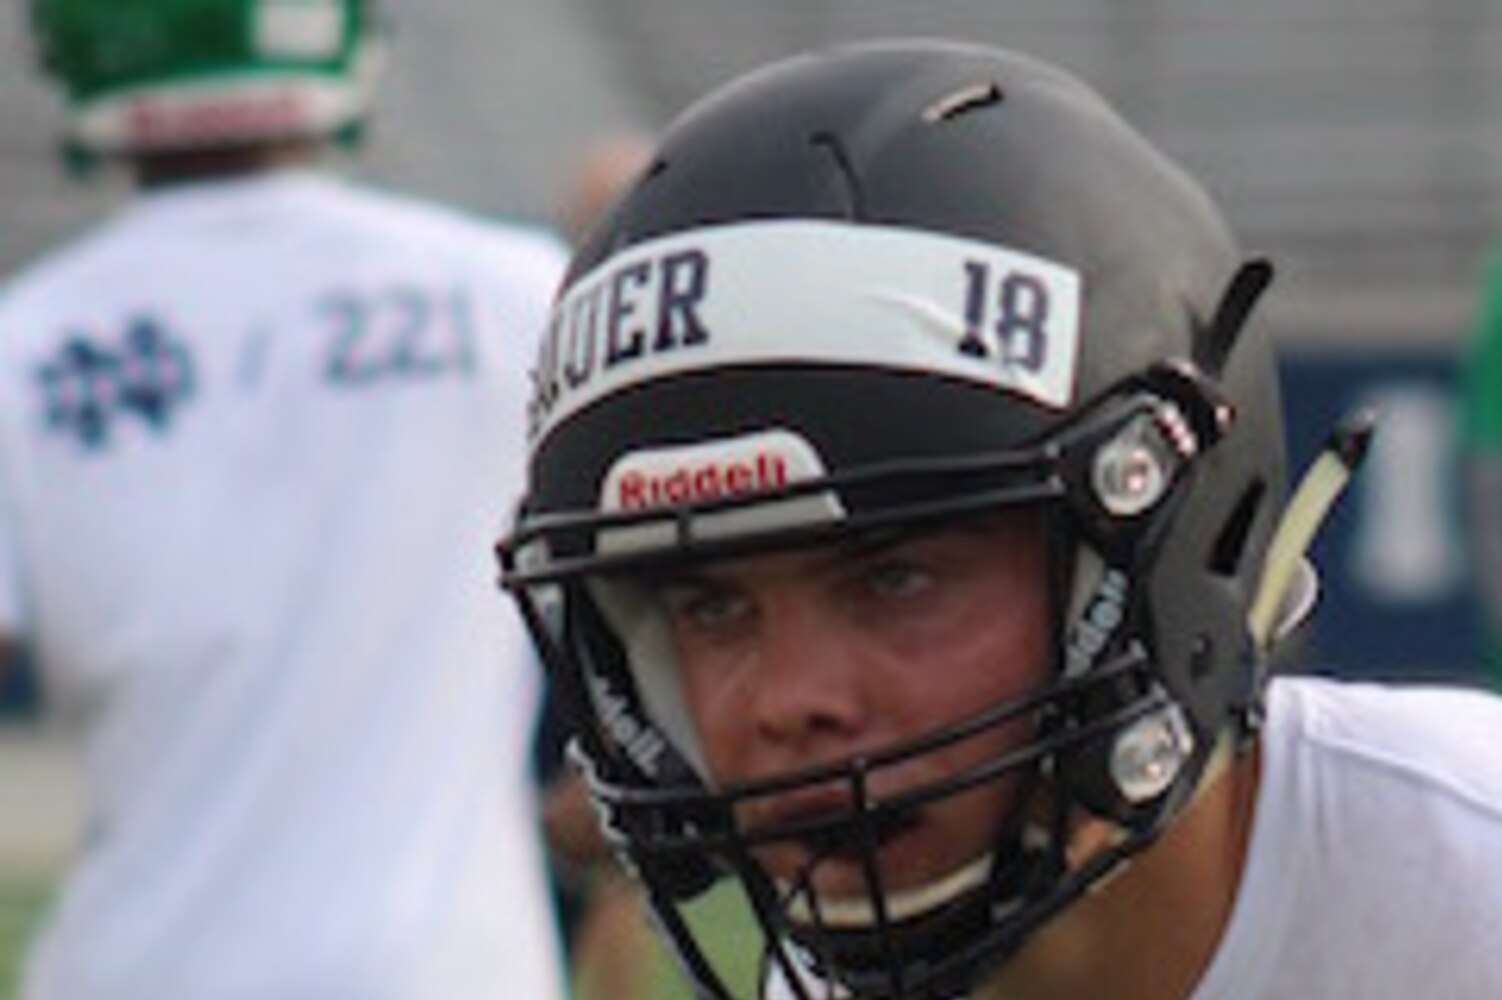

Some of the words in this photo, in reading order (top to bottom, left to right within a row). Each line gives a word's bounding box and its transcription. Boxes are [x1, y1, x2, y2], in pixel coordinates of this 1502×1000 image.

[318, 286, 478, 387] 221
[952, 260, 1050, 372] 18
[619, 451, 787, 510] Riddell
